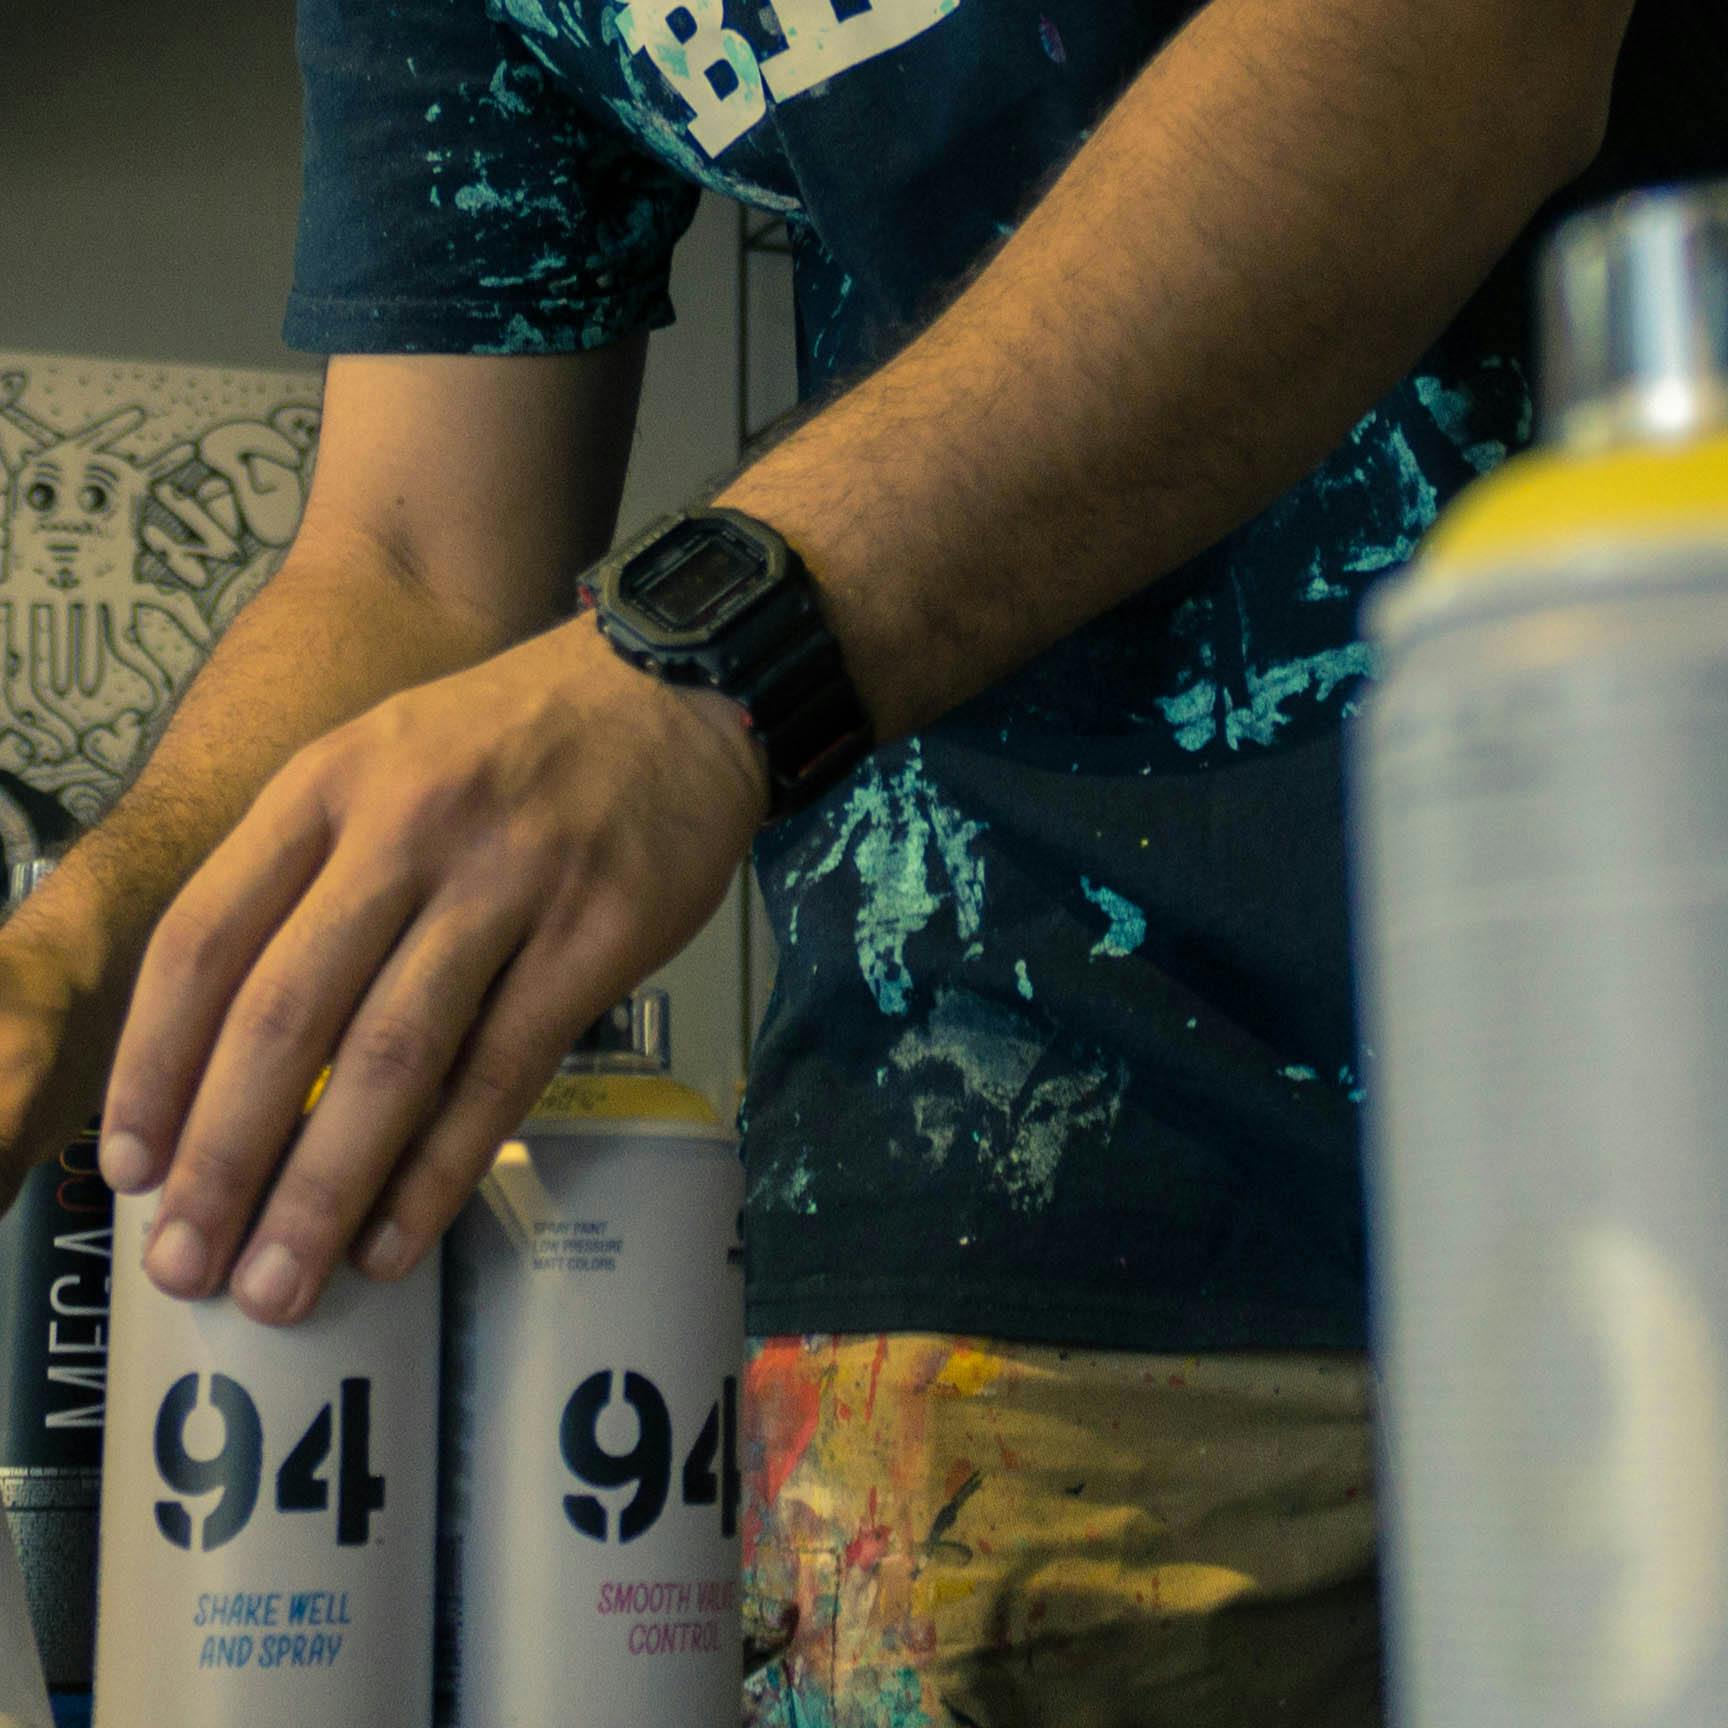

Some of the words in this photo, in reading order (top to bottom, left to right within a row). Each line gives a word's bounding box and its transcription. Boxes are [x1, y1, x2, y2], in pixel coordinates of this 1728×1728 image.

[153, 1371, 386, 1553] 94
[559, 1367, 742, 1544] 94
[193, 1592, 282, 1626] SHAKE
[287, 1592, 351, 1625] WELL
[597, 1581, 692, 1615] SMOOTH
[198, 1634, 254, 1669] AND
[257, 1633, 344, 1668] SPRAY
[627, 1623, 723, 1656] CONTROL
